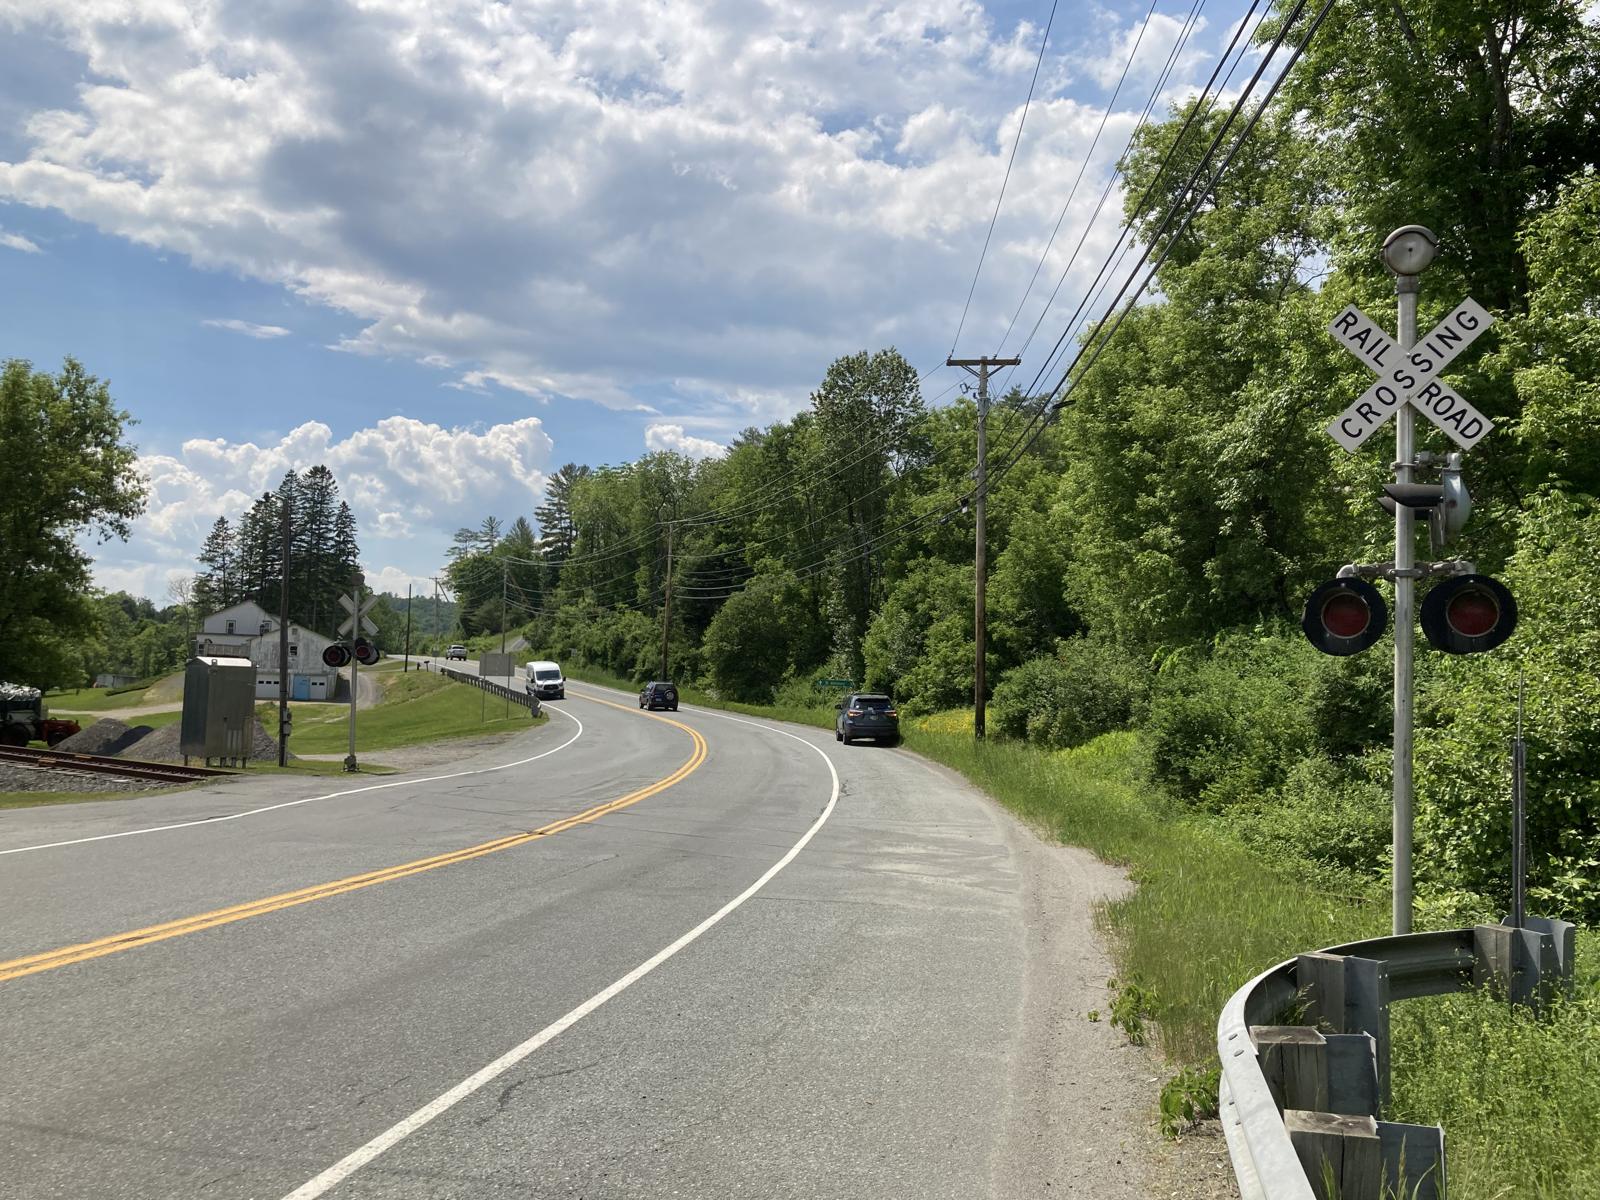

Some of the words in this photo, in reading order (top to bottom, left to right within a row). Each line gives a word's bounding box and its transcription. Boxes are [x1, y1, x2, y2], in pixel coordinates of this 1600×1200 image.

[1335, 311, 1391, 368] RAIL
[1417, 382, 1483, 440] ROAD
[1341, 310, 1479, 439] CROSSING
